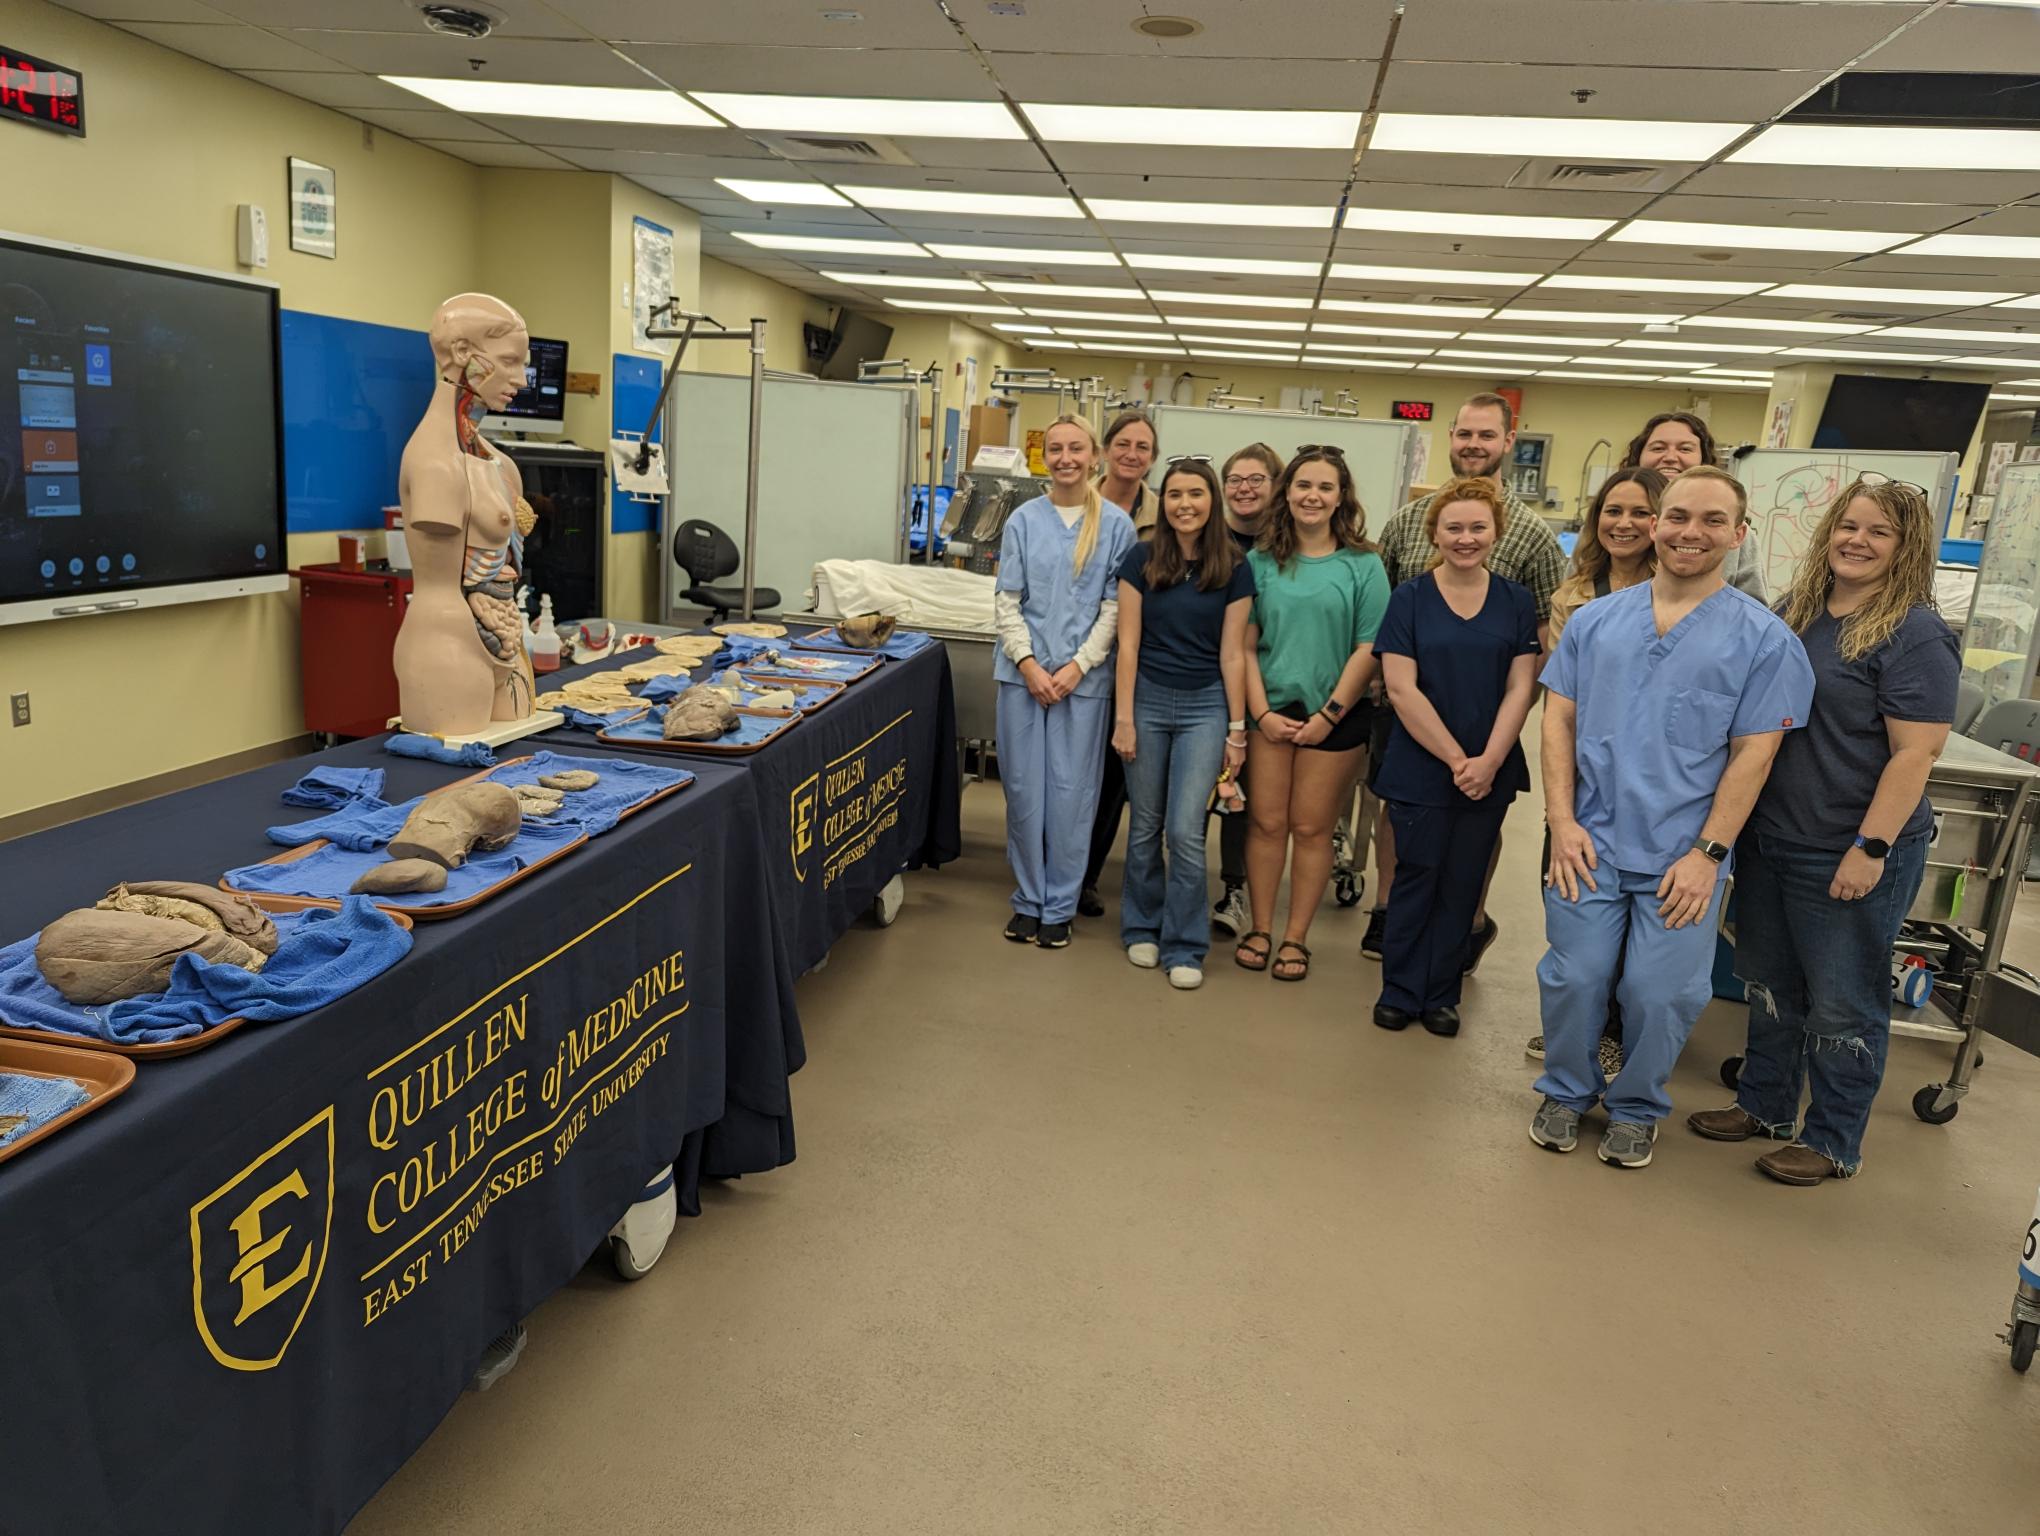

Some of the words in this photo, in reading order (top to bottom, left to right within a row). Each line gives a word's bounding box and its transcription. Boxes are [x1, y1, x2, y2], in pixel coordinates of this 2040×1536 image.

[2026, 712, 2038, 728] 2
[364, 1250, 432, 1328] EAST
[439, 1150, 544, 1264] TENNESSEE
[554, 1105, 588, 1166] STATE
[592, 1031, 672, 1118] UNIVERSITY
[366, 1069, 528, 1235] COLLEGE
[541, 1040, 567, 1110] of
[567, 950, 686, 1078] MEDICINE
[368, 993, 529, 1151] QUILLEN
